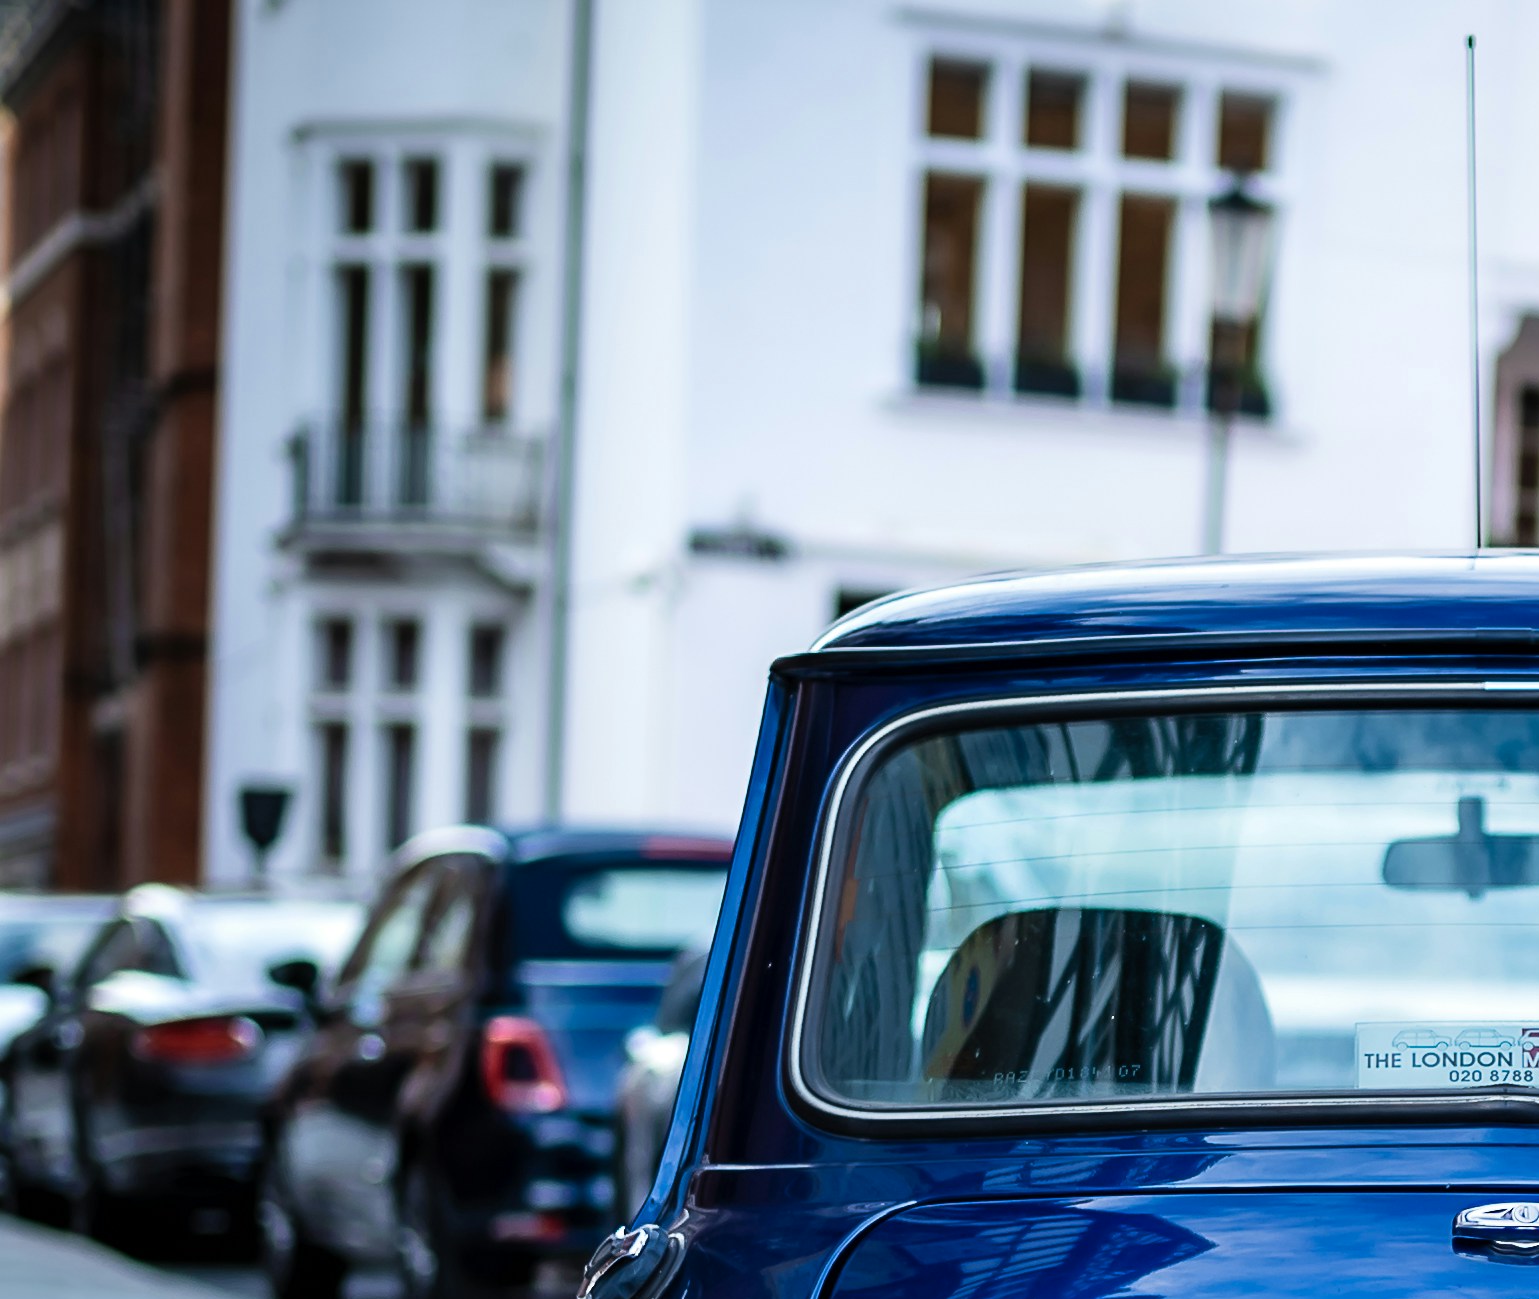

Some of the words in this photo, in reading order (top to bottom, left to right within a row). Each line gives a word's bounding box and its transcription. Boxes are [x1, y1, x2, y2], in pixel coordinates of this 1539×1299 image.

[1364, 1052, 1402, 1069] THE
[1412, 1051, 1513, 1068] LONDON
[1448, 1069, 1483, 1083] 020
[1489, 1069, 1534, 1083] 8788
